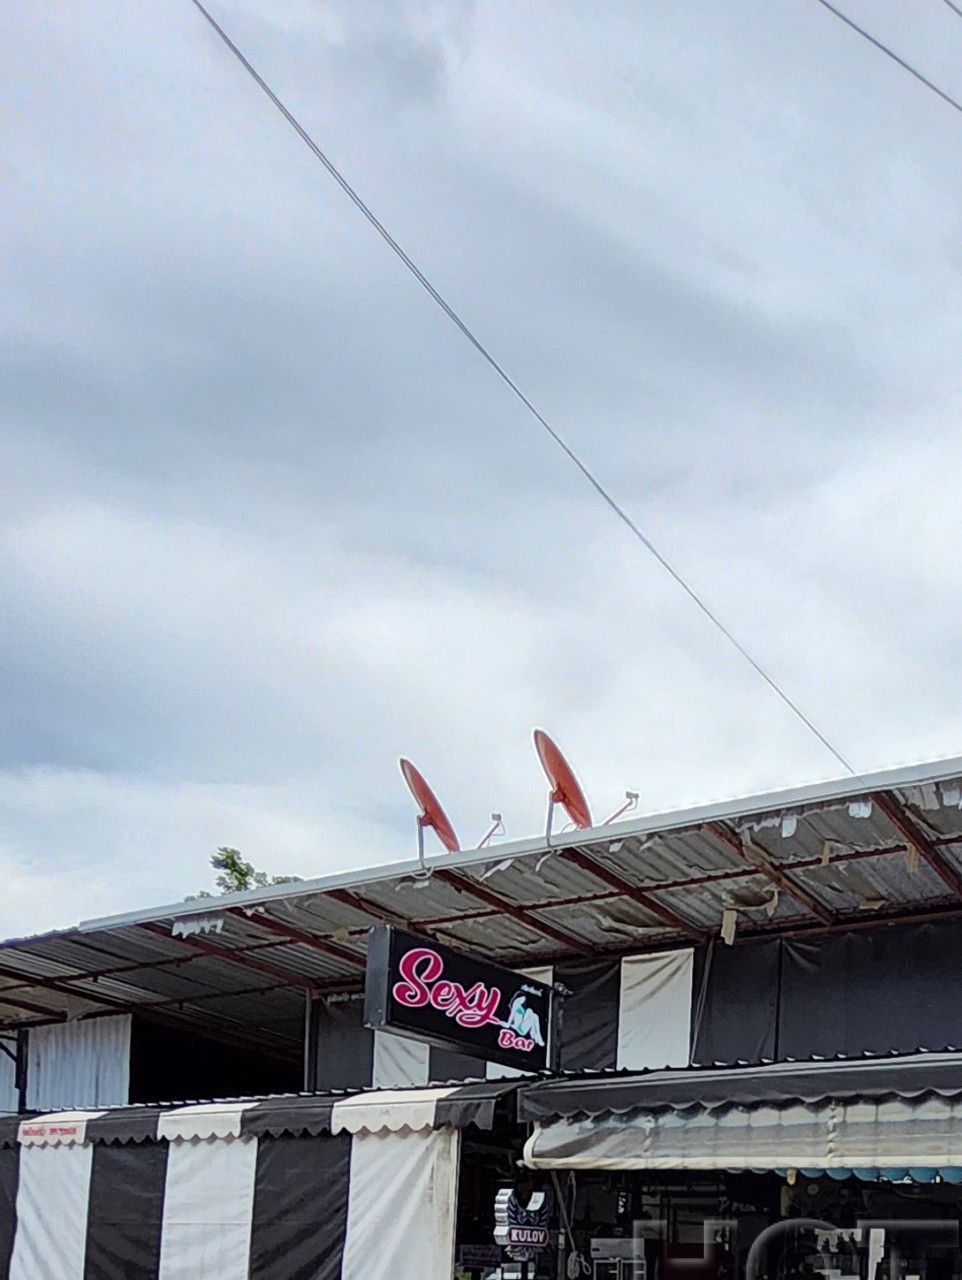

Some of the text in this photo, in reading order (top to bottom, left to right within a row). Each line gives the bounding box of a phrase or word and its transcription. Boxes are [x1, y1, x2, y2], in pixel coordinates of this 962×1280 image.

[392, 947, 502, 1029] Sexy
[498, 1028, 535, 1051] Bar
[510, 1228, 546, 1243] KULOV
